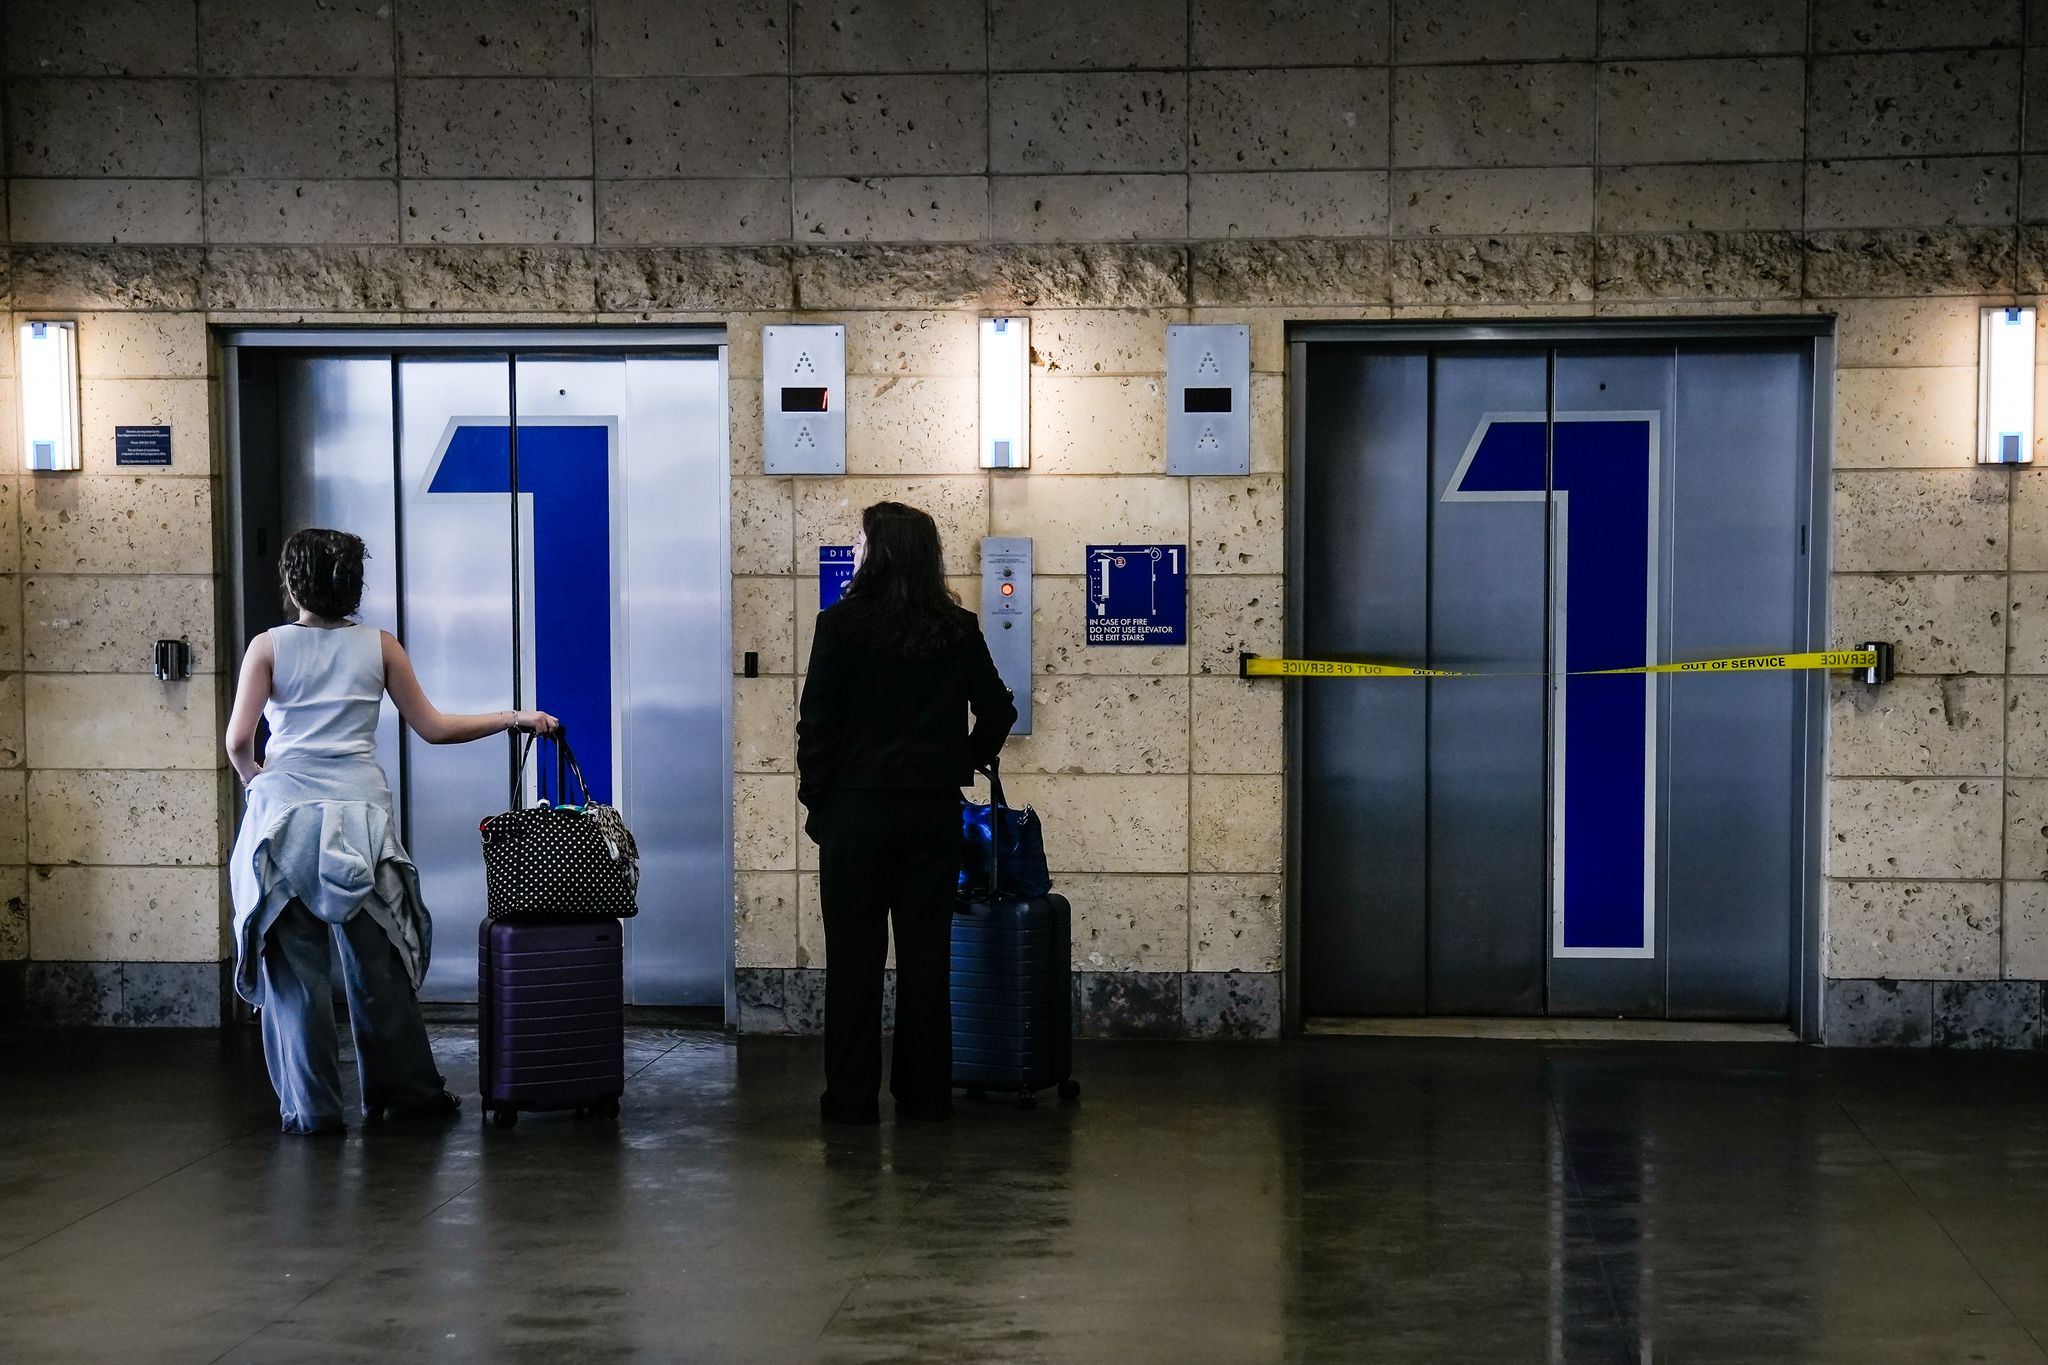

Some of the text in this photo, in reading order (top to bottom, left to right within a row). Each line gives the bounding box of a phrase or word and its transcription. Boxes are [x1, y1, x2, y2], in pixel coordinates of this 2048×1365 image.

[829, 549, 852, 558] DIR
[1167, 548, 1178, 575] 1
[1089, 618, 1148, 626] IN CASE OF FIRE
[1089, 626, 1174, 634] DO NOT USE ELEVATOR
[1089, 634, 1145, 642] USE EXIT STAIRS
[1680, 657, 1786, 670] OUT OF SERVICE
[415, 415, 625, 946] 1
[1441, 410, 1661, 958] 1
